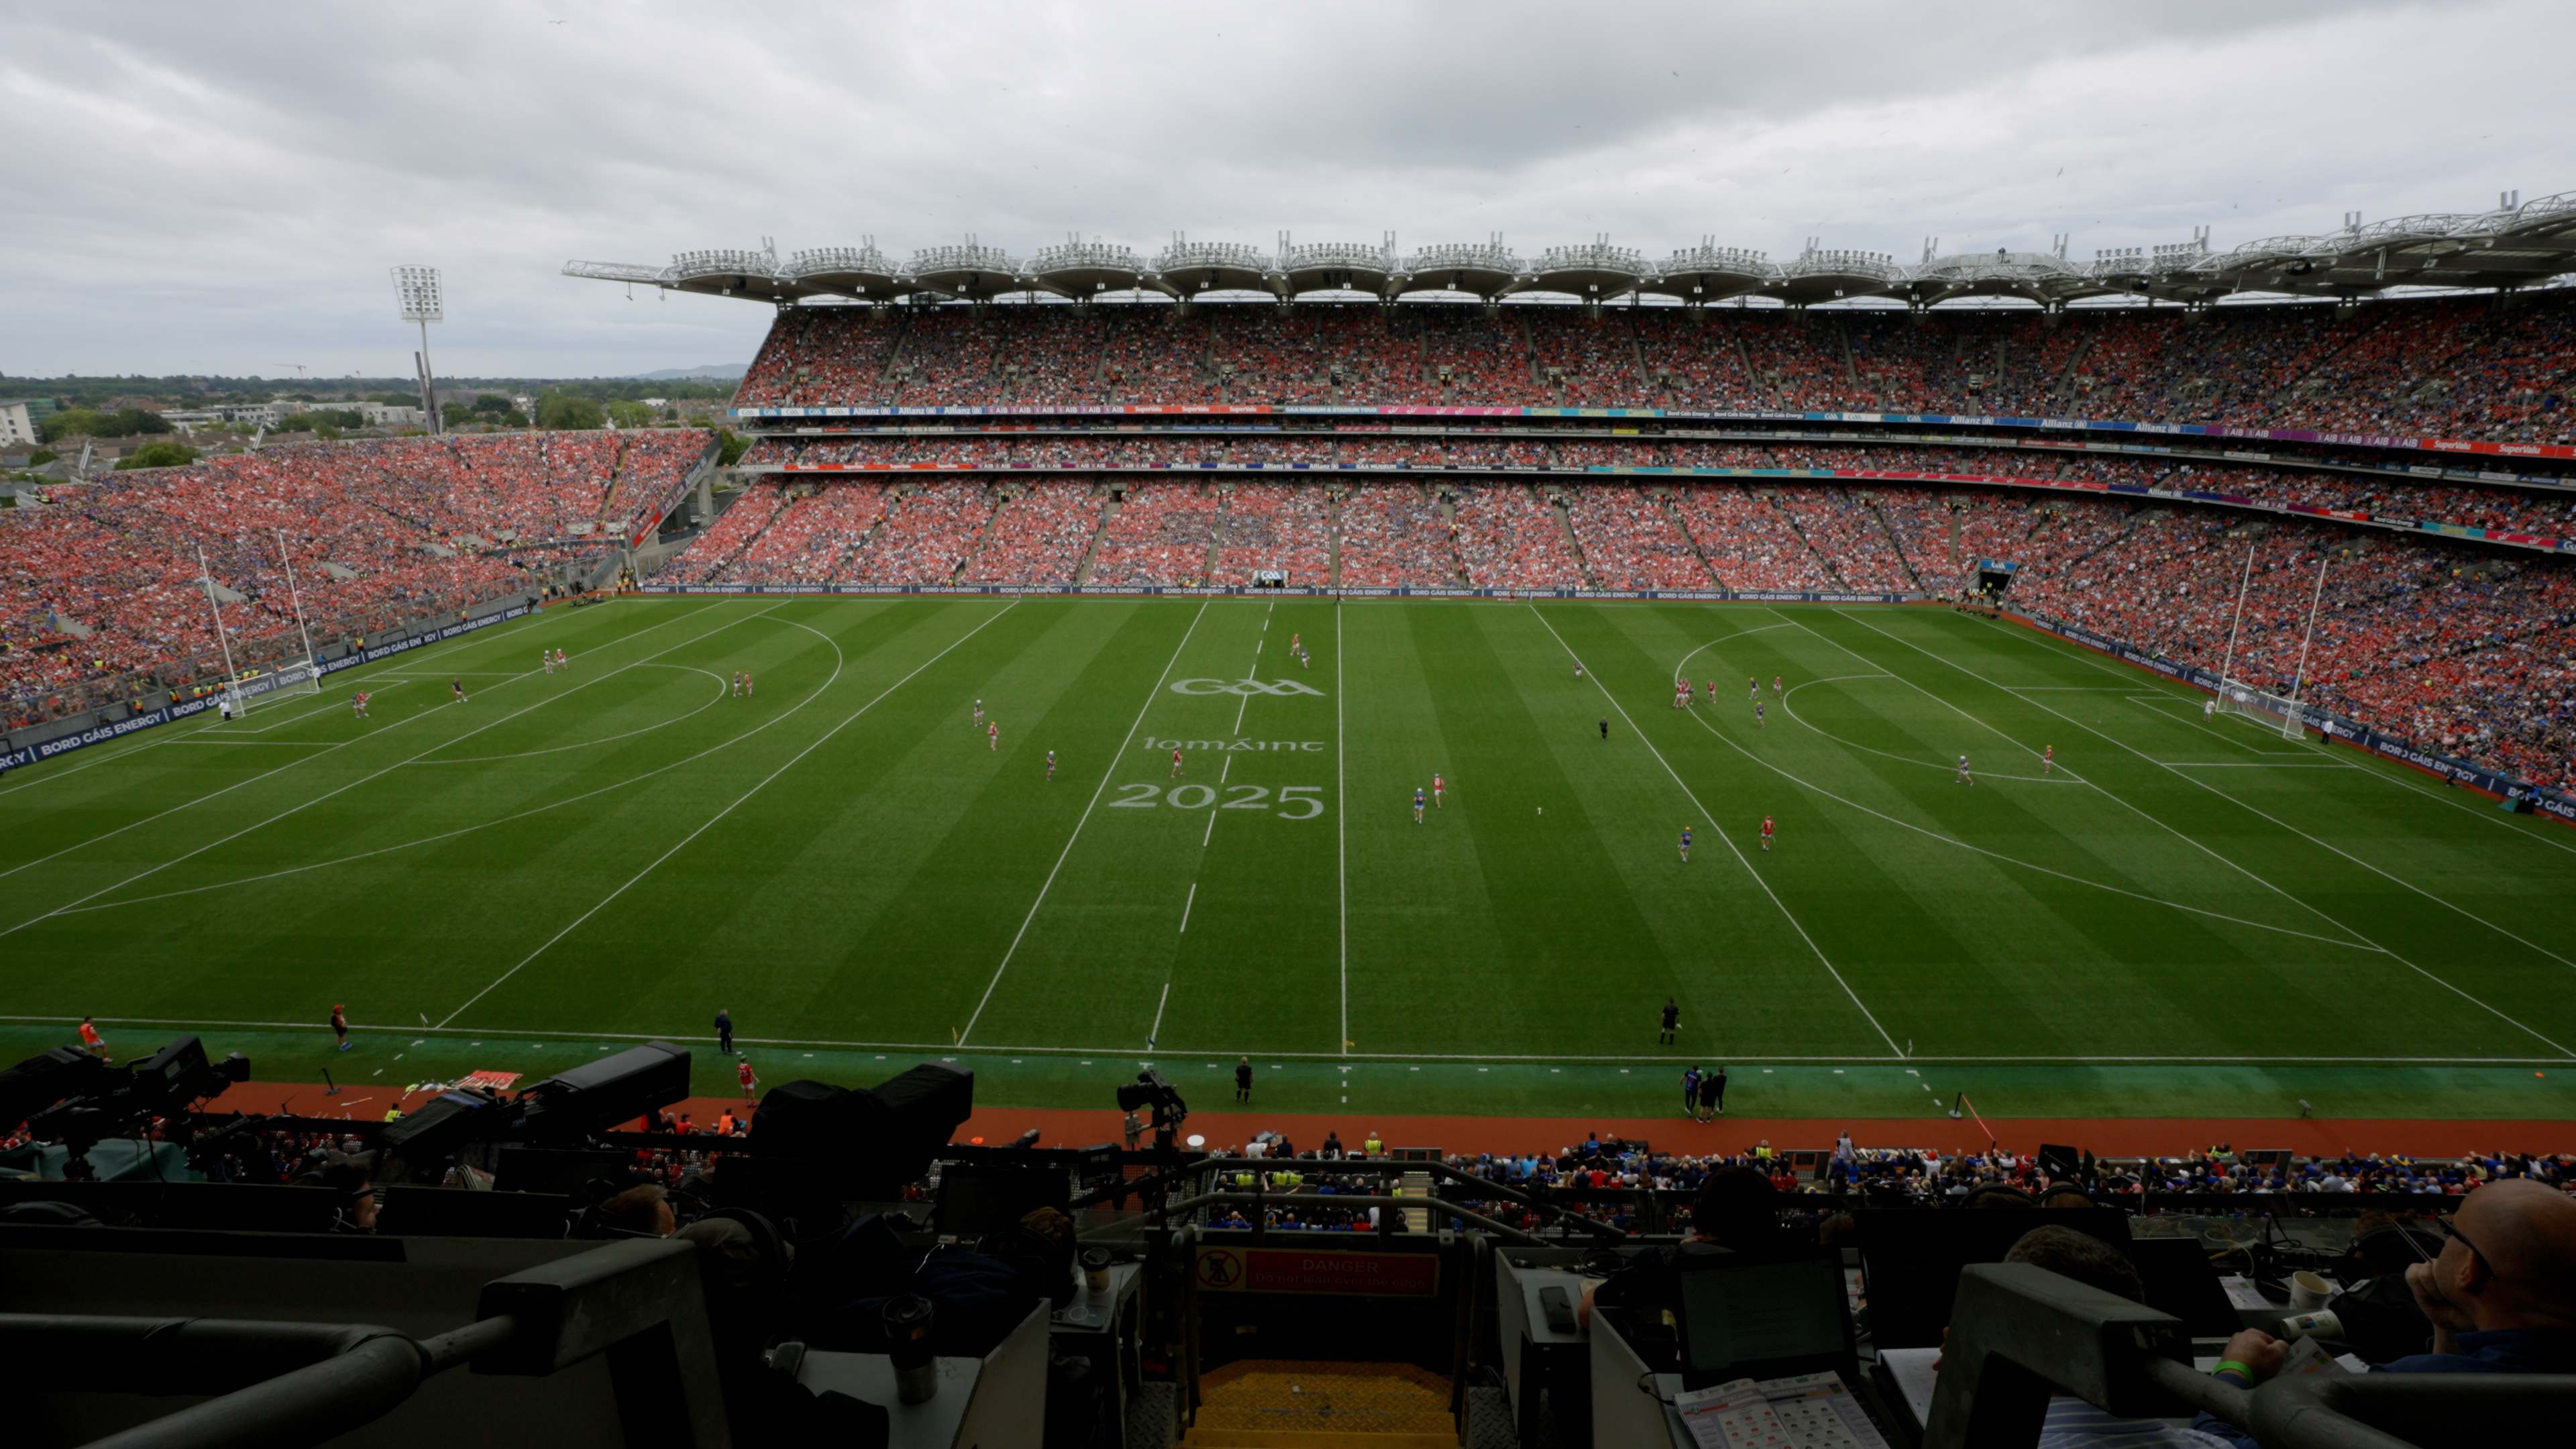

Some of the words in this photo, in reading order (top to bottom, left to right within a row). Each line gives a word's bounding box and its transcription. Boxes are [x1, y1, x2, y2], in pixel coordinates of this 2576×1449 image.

[1949, 415, 1980, 425] Allianz
[2041, 419, 2073, 429] Allianz
[2135, 423, 2166, 433] Allianz
[2230, 429, 2243, 437] AIB
[2255, 429, 2269, 437] AIB
[2324, 434, 2338, 443] AIB
[2347, 435, 2362, 444] AIB
[2373, 437, 2390, 445] AIB
[2402, 439, 2418, 448] AIB
[2434, 440, 2471, 451] SuperValu
[2498, 443, 2541, 455] SuperValu
[2147, 488, 2173, 496] Allianz
[443, 626, 462, 637] BORD
[478, 614, 501, 629] ENERGY
[2036, 619, 2054, 631] ENERGY
[368, 648, 390, 660] BORD
[409, 633, 437, 647] ENRGY
[2065, 630, 2079, 640] BORD
[2091, 639, 2111, 652] ENERGY
[2124, 651, 2140, 661] BORD
[2154, 661, 2179, 676] ENERGY
[279, 671, 306, 686] BORD
[328, 657, 360, 672] ENERGY
[1169, 678, 1326, 697] GAA
[2194, 675, 2212, 689] BORD
[172, 698, 205, 717] BORD
[2302, 712, 2320, 728] GÁIS
[40, 735, 81, 756] BORD
[82, 727, 113, 744] GÁIS
[114, 712, 161, 735] ENERGY
[2410, 752, 2434, 769] GÁIS
[2434, 761, 2477, 785] ENRGY
[1109, 784, 1324, 820] 2025
[2545, 799, 2576, 818] GÁIS
[1302, 1258, 1379, 1274] DANGER
[1255, 1272, 1273, 1283] Do
[1277, 1274, 1299, 1284] not
